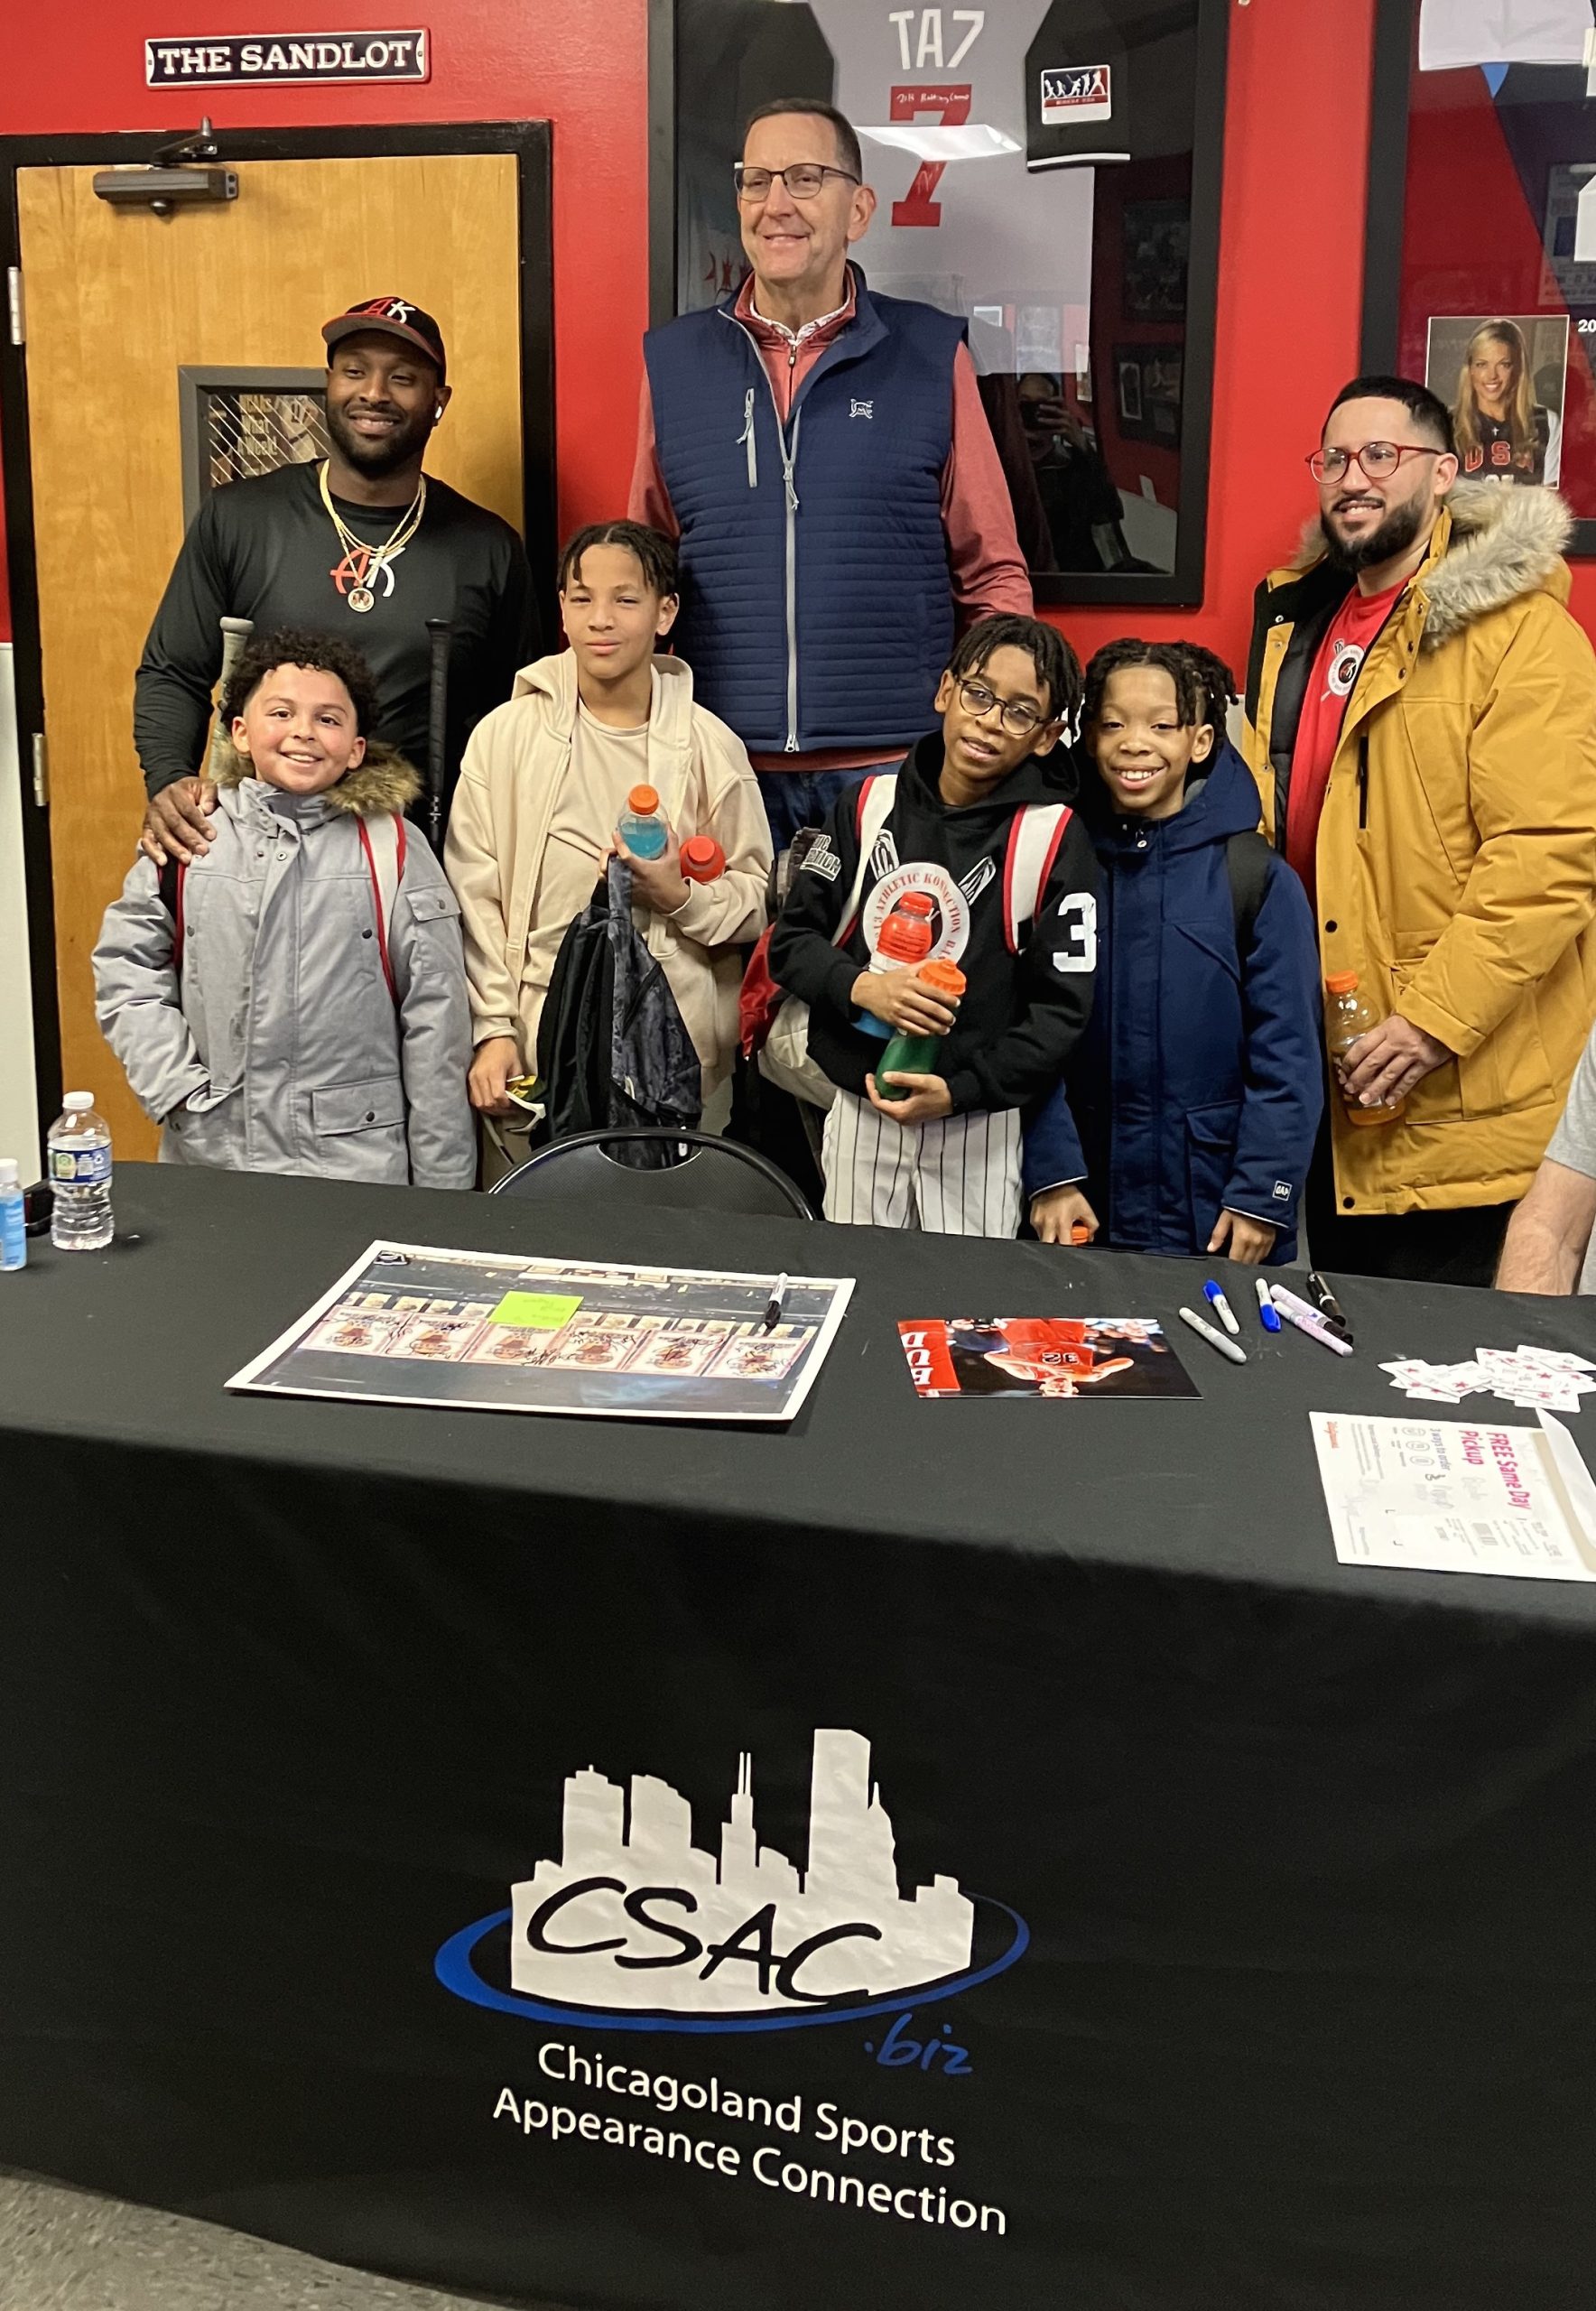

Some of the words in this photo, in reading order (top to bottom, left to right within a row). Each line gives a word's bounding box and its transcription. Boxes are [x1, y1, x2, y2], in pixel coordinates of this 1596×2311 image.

[157, 46, 232, 75] THE
[240, 41, 412, 72] SANDLOT
[889, 8, 985, 70] TA7
[330, 545, 406, 598] AK
[876, 873, 921, 911] ATHLETIC
[1053, 892, 1097, 972] 3
[1458, 1429, 1486, 1466] Pickup
[1487, 1431, 1516, 1459] FREE
[1496, 1459, 1523, 1490] Same
[1507, 1490, 1533, 1510] Day
[526, 1876, 882, 2004] CSAC
[864, 2013, 973, 2074] .biz
[537, 2041, 803, 2133] Chicagoland
[813, 2103, 956, 2167] Sports
[492, 2086, 741, 2176] Appearance
[752, 2146, 1007, 2235] Connection
